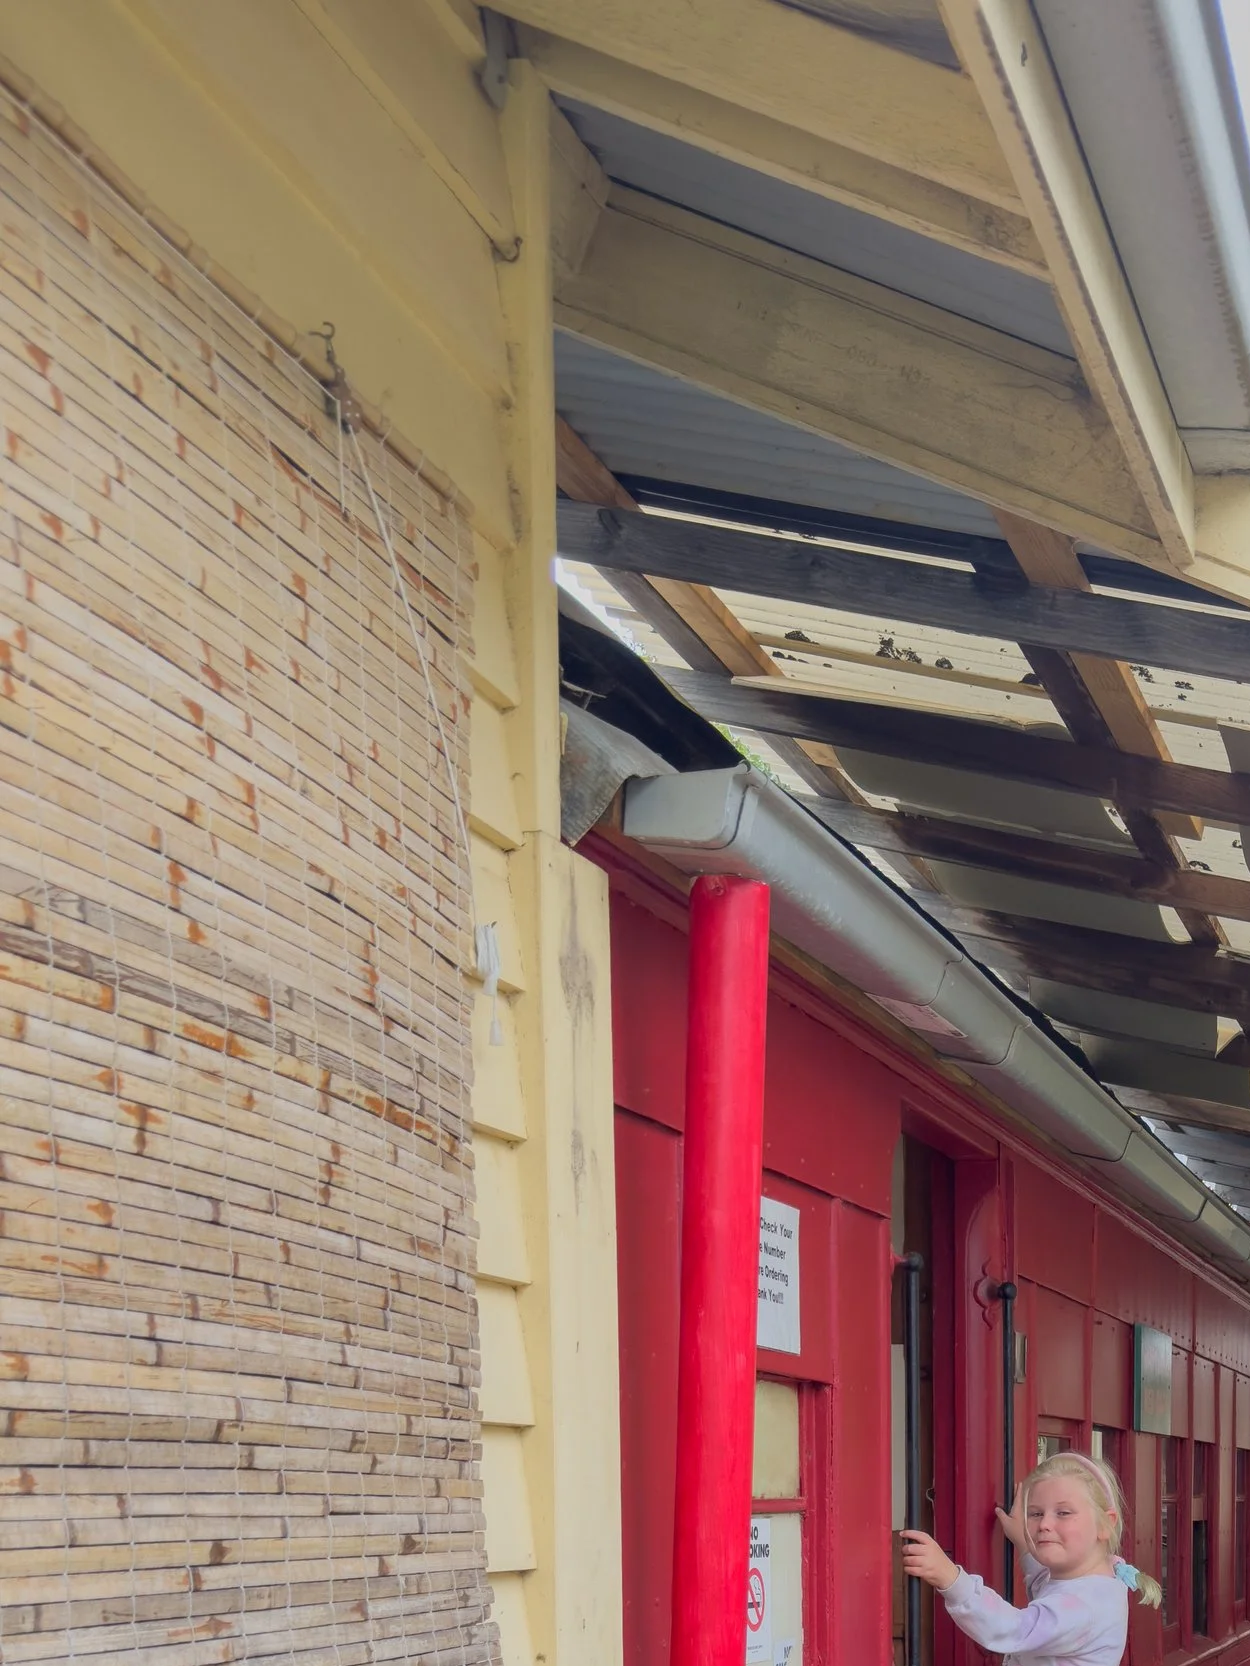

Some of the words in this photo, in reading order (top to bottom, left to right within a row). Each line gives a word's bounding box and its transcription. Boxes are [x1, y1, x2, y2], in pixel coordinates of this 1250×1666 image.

[760, 1217, 778, 1234] Check
[780, 1223, 793, 1239] Your
[763, 1242, 786, 1260] Number
[764, 1265, 789, 1287] Ordering
[749, 1543, 770, 1559] OKING
